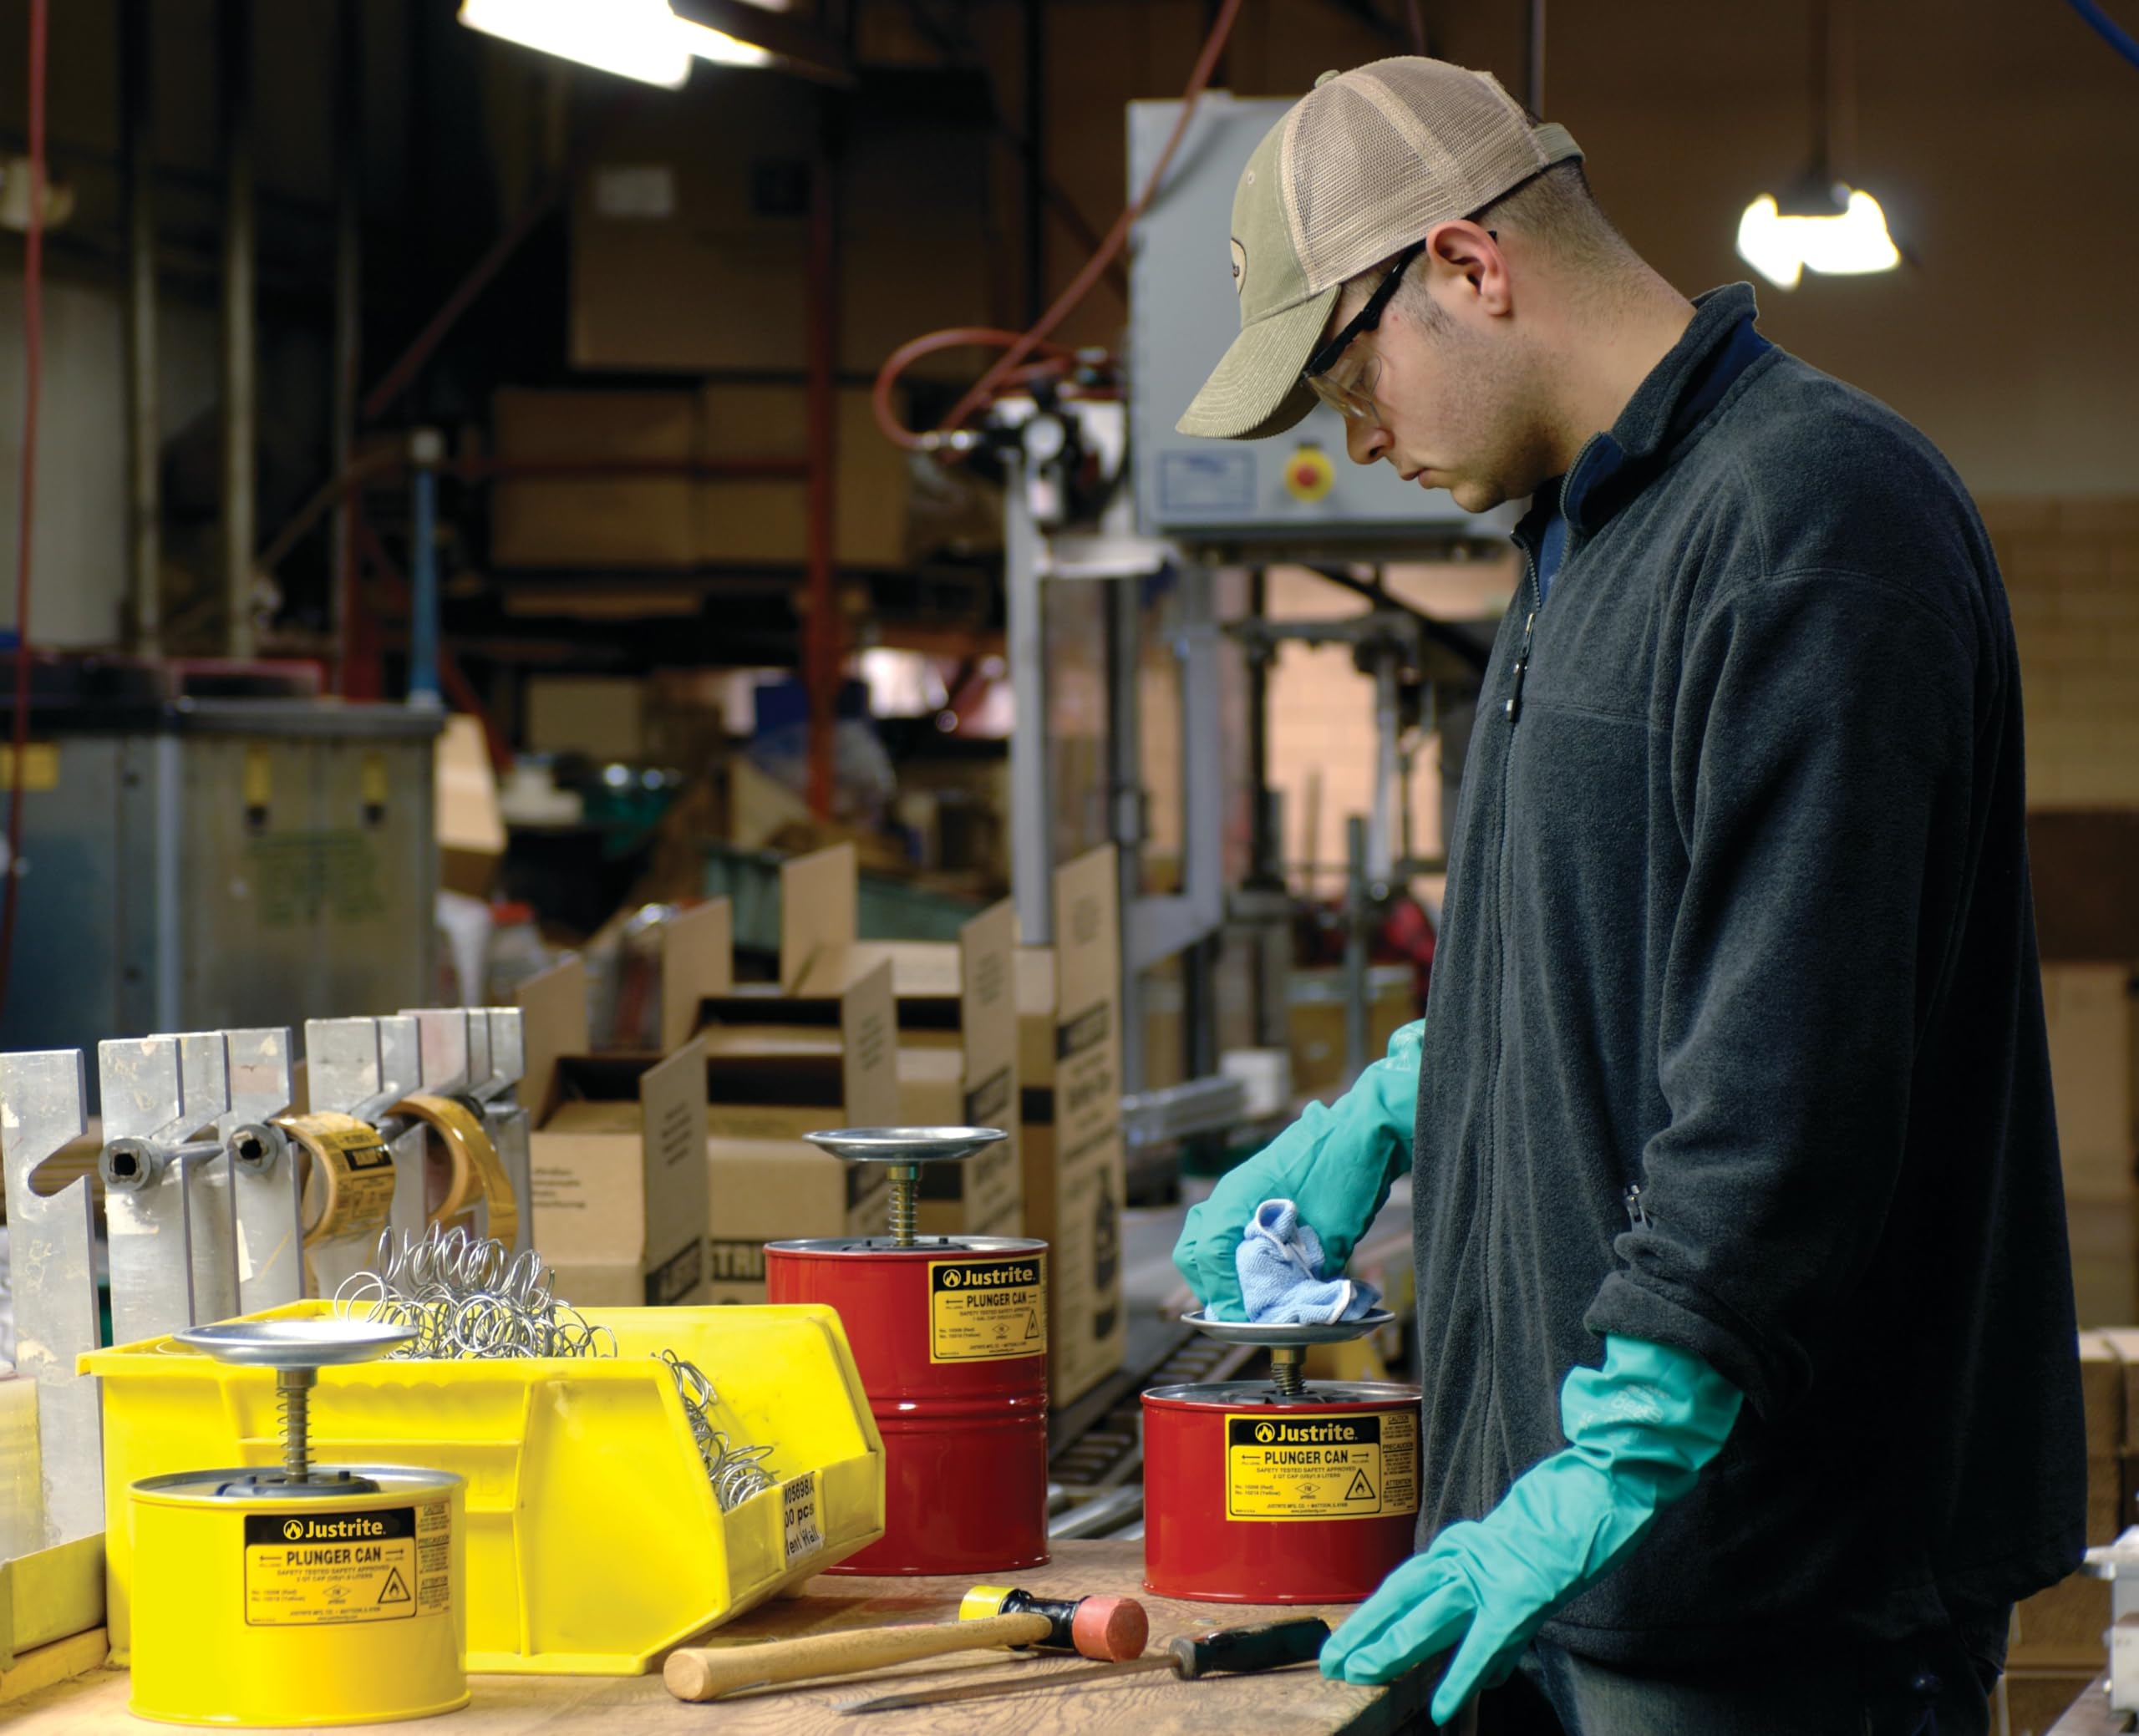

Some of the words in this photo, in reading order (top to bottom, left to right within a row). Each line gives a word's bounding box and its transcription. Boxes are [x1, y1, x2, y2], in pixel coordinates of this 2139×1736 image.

[715, 1244, 762, 1277] TRI
[963, 1266, 1034, 1286] Justrite
[967, 1293, 1009, 1307] PLUNGER
[1013, 1292, 1026, 1304] CAN
[1277, 1423, 1356, 1442] Justrite
[1264, 1451, 1320, 1464] PLUNGER
[1324, 1450, 1349, 1463] CAN
[797, 1504, 815, 1526] pcs
[306, 1519, 383, 1537] Justrite
[287, 1549, 352, 1566] PLUNGER
[356, 1547, 381, 1561] CAN
